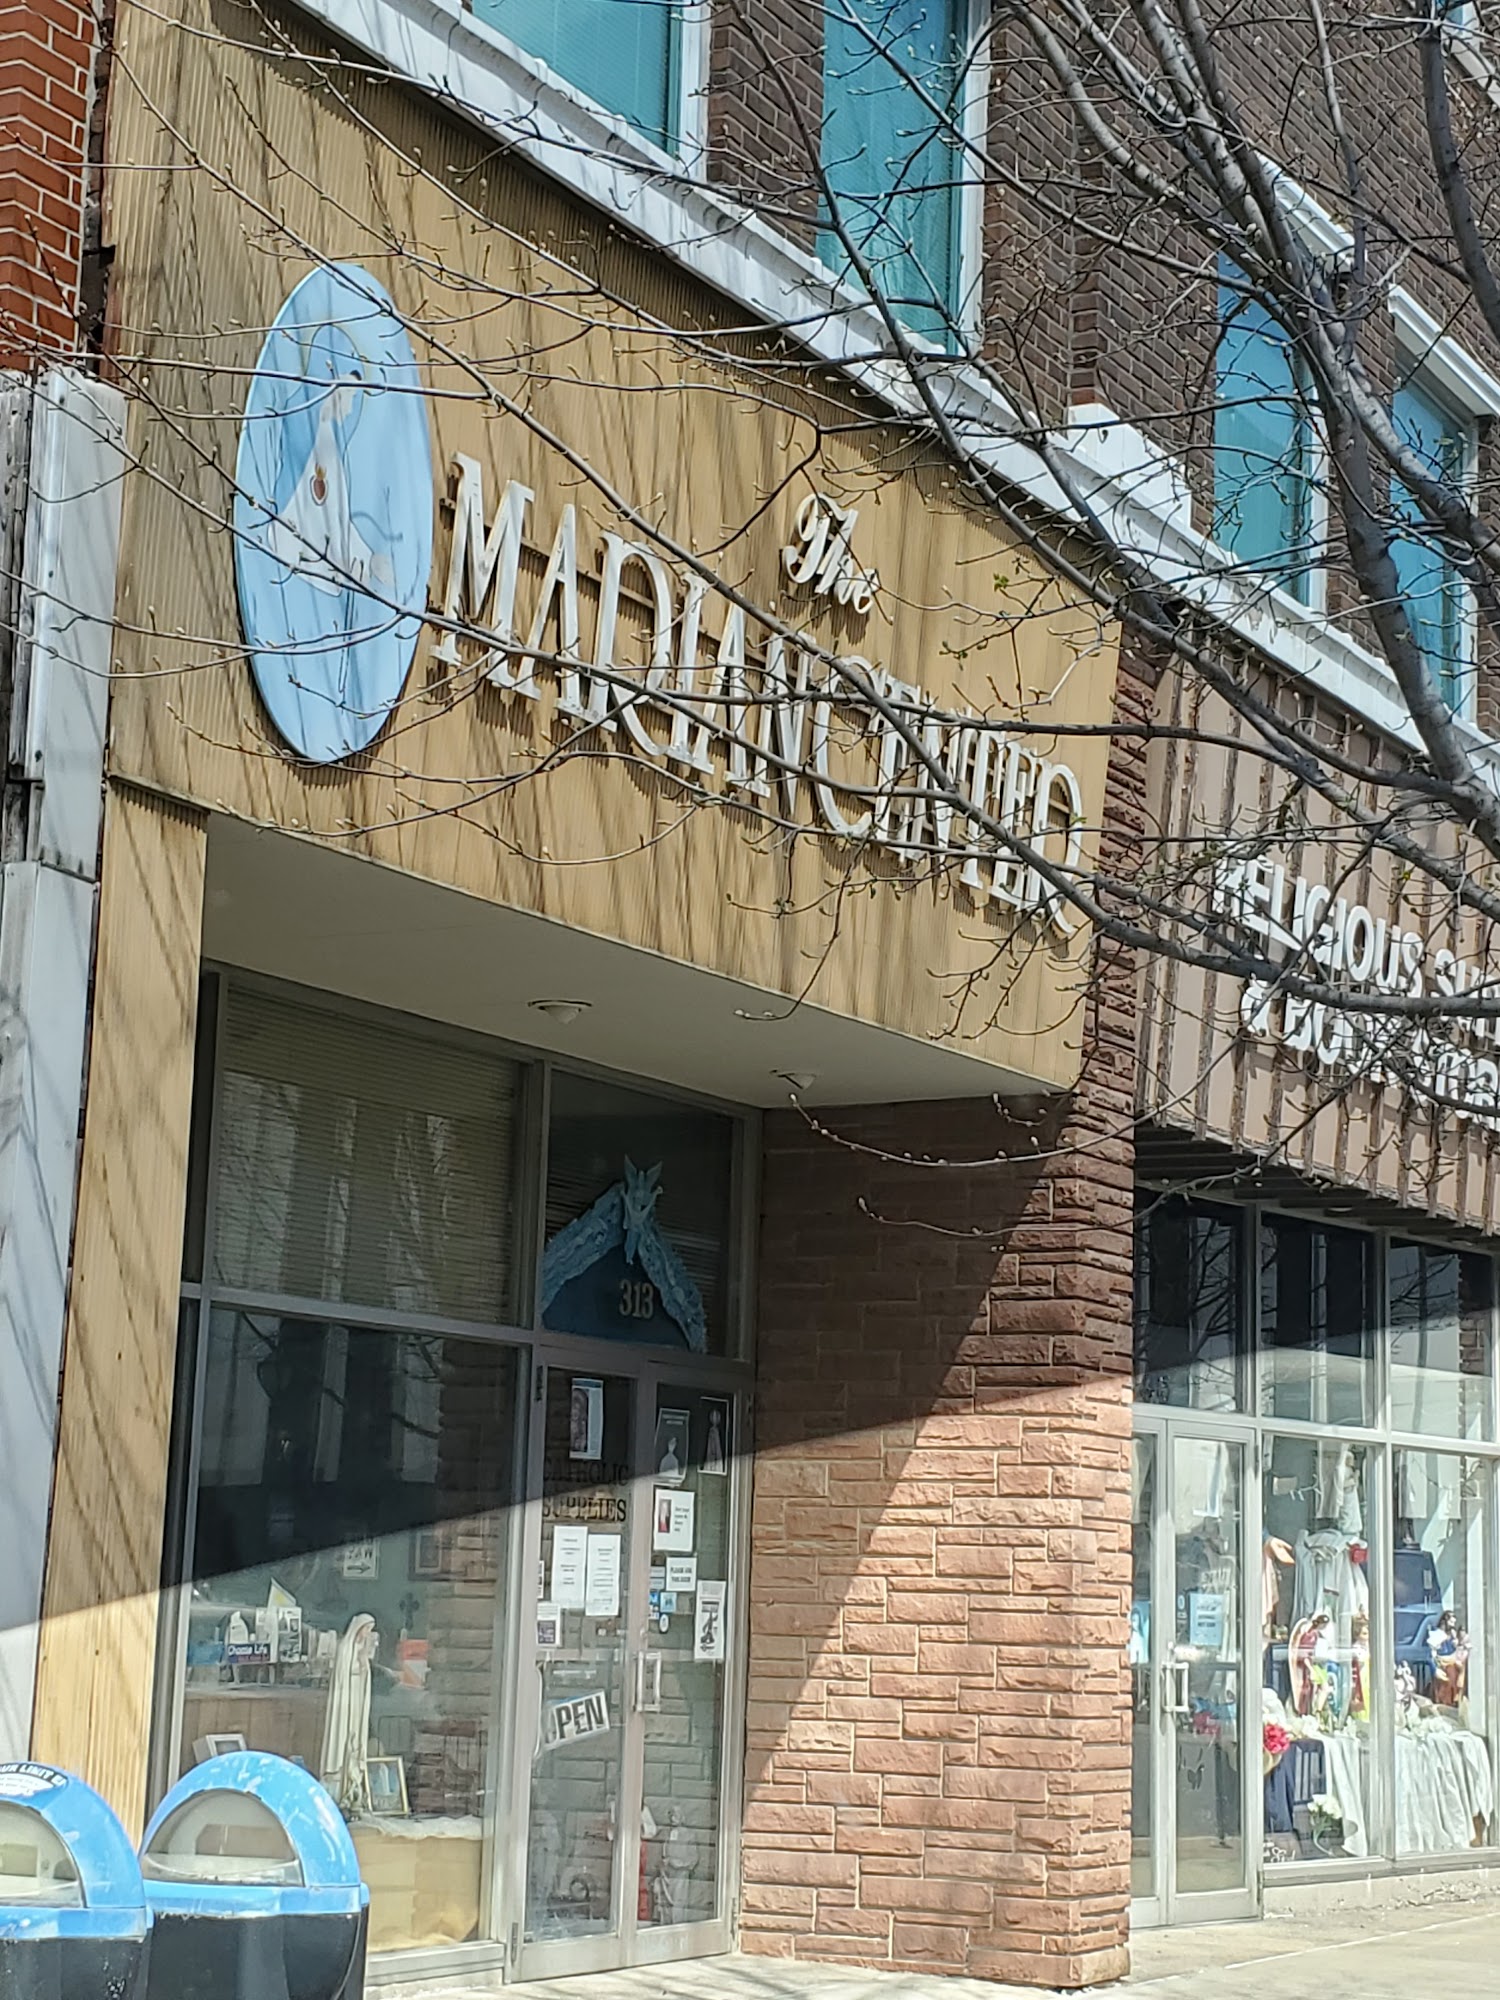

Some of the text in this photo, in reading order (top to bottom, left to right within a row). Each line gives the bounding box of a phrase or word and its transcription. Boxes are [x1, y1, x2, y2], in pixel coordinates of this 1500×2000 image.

[782, 492, 881, 615] The
[430, 452, 1083, 935] MARIAN CENTER
[619, 1279, 654, 1319] 313
[543, 1496, 627, 1522] SUPPLIES
